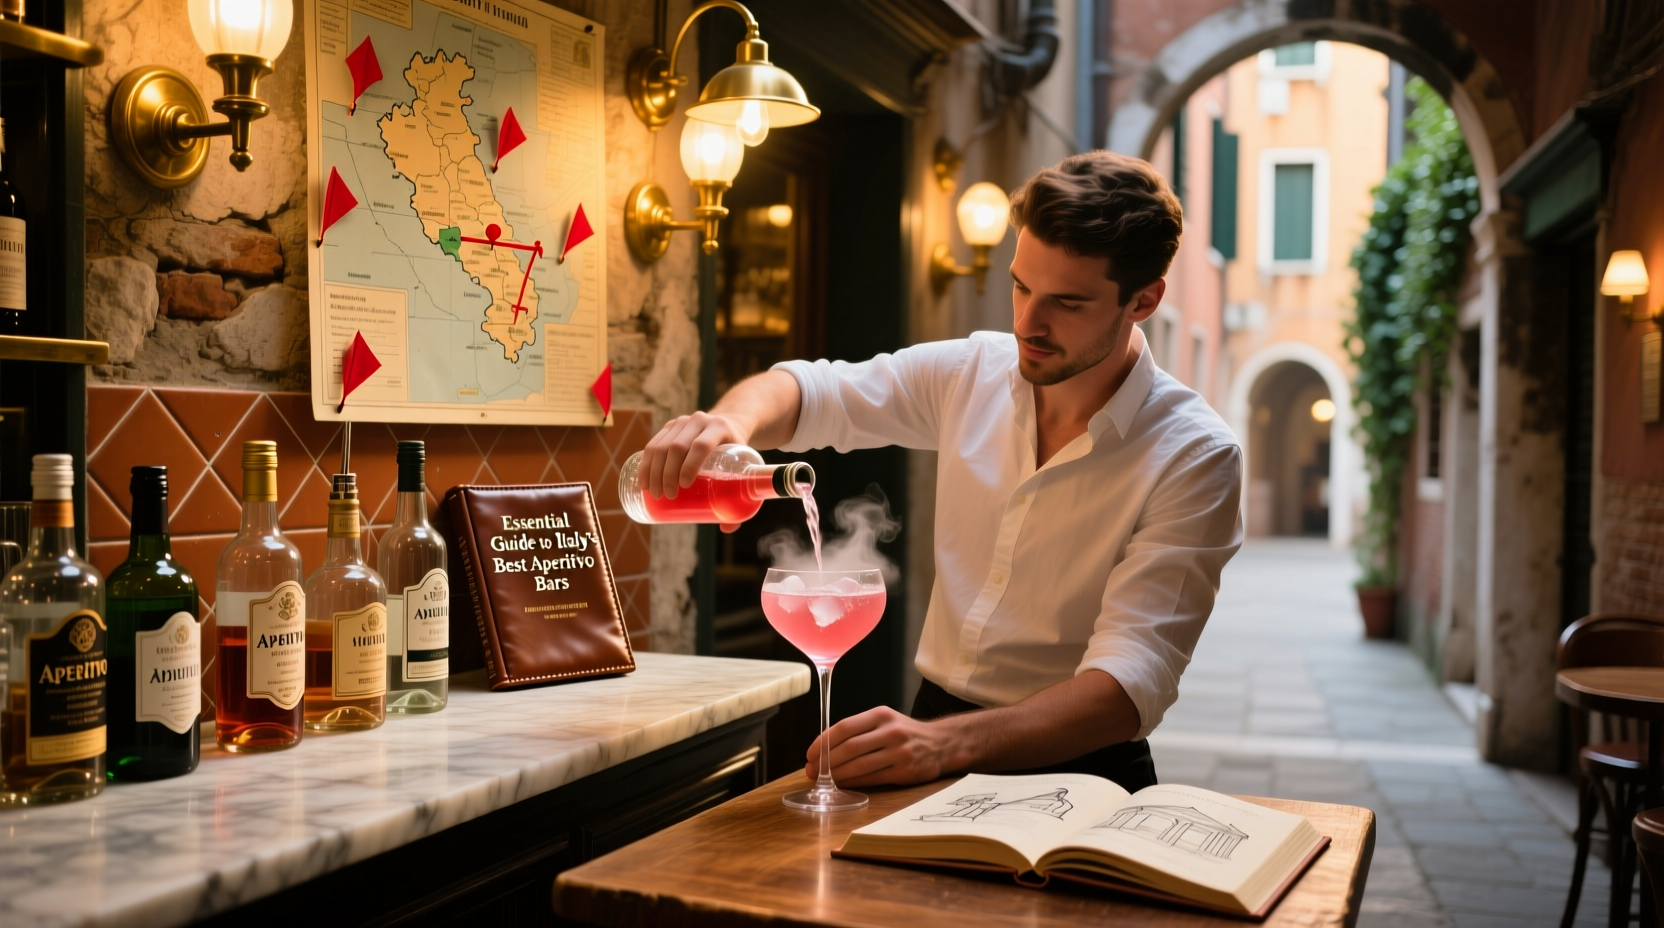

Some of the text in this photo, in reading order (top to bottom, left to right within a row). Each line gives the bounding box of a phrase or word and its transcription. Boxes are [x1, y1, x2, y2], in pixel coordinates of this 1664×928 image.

[501, 512, 571, 531] Essential
[490, 533, 537, 552] Guide
[539, 537, 552, 550] to
[492, 557, 528, 574] Best
[534, 575, 570, 592] Bars
